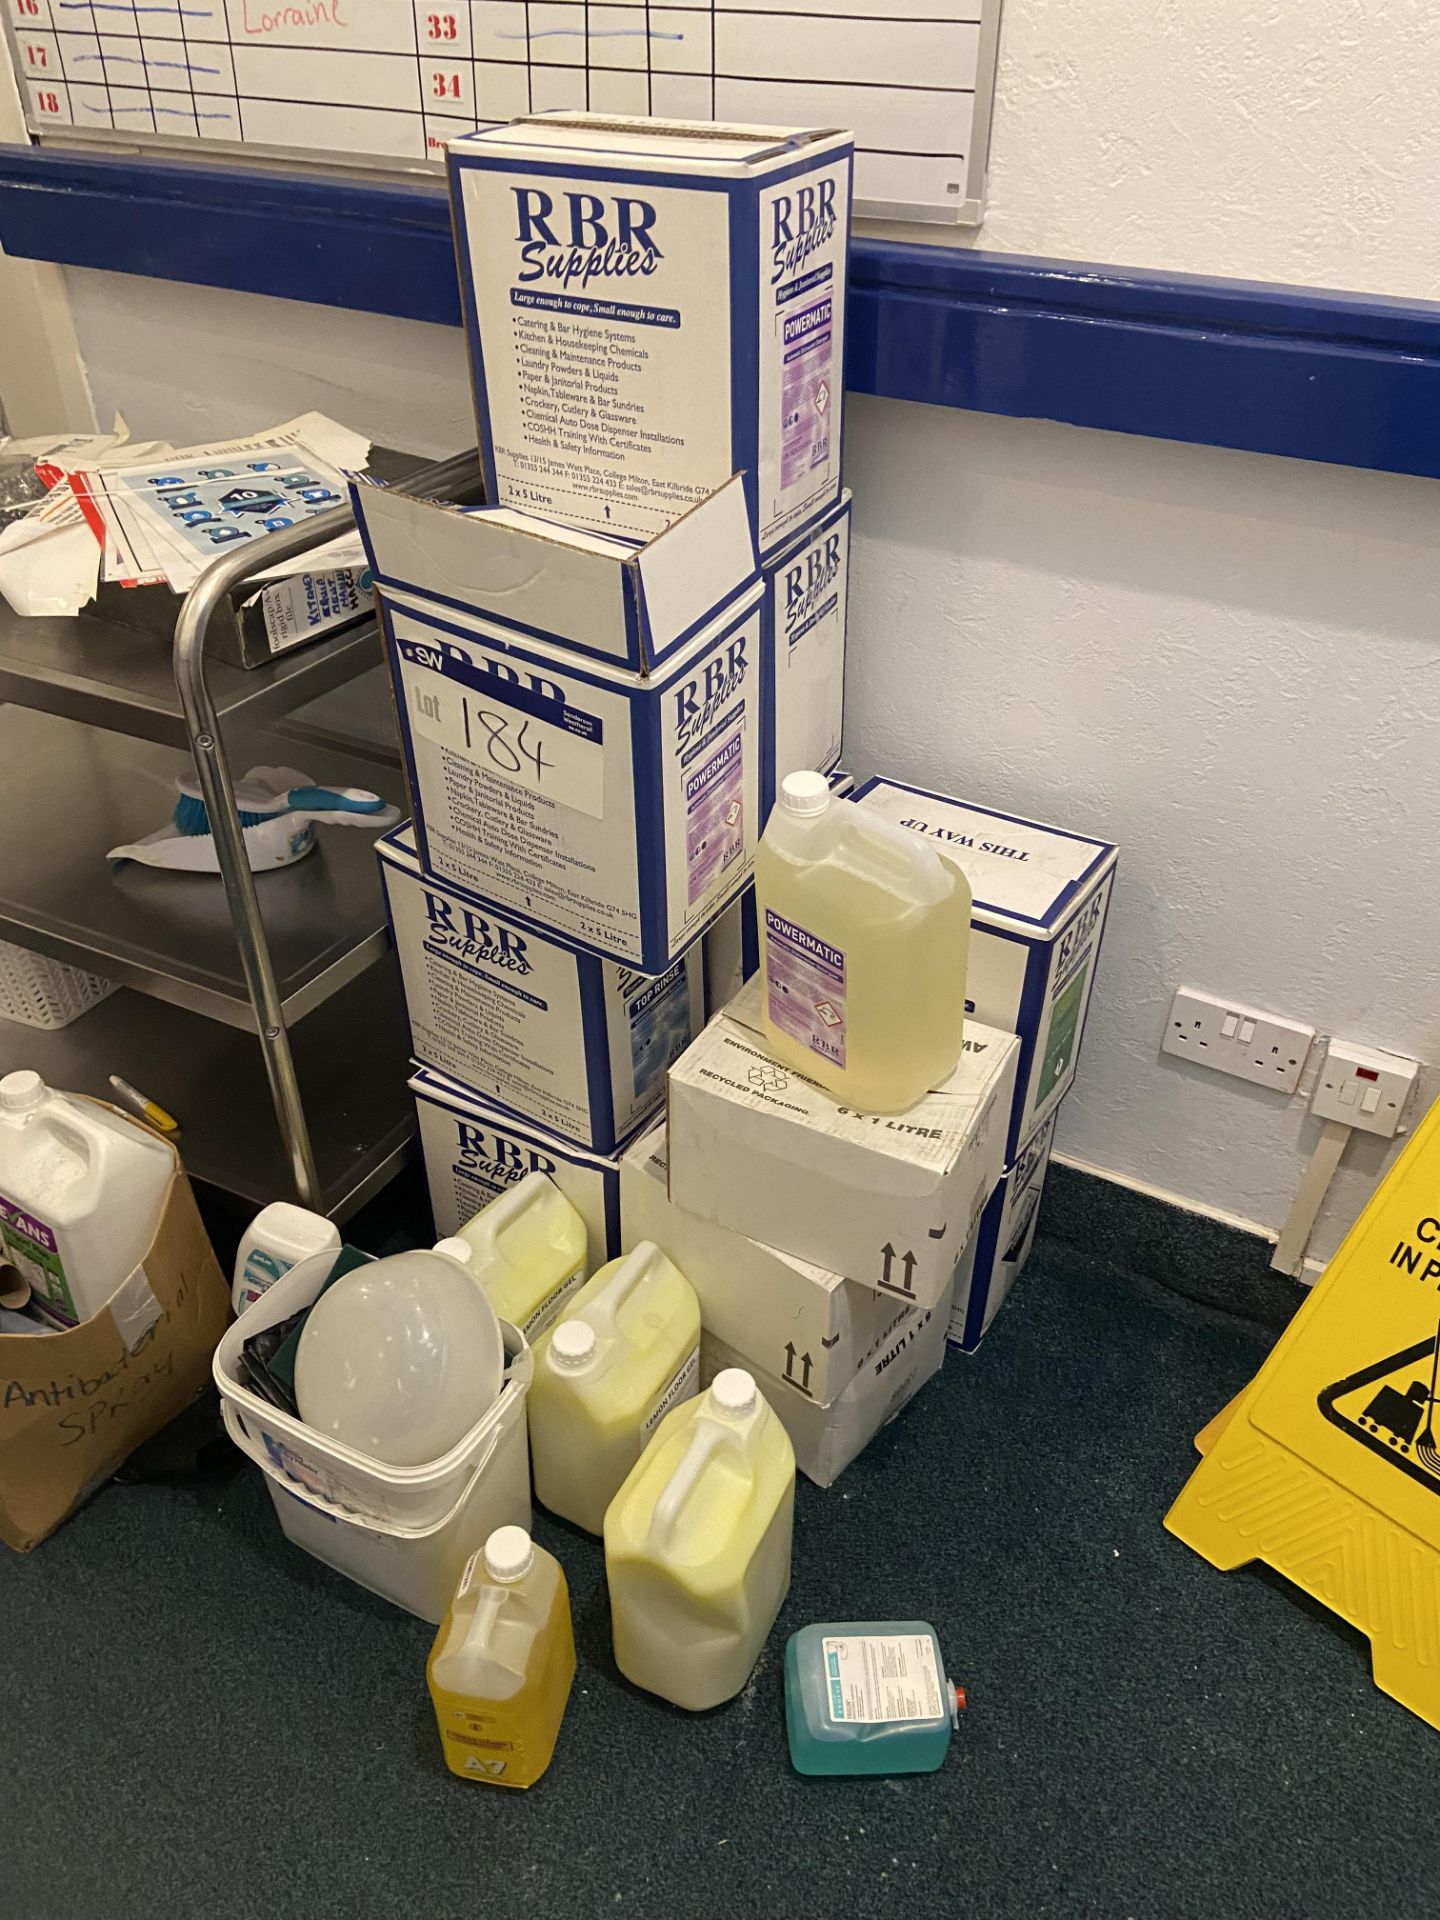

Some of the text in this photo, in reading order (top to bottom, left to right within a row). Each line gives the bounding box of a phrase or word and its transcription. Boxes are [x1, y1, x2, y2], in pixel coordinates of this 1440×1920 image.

[428, 14, 457, 40] 33
[27, 46, 47, 68] 17
[433, 73, 462, 98] 34
[37, 92, 59, 114] 18
[510, 187, 664, 259] RBR
[771, 179, 837, 249] RBR
[518, 235, 658, 289] Supplies
[771, 217, 834, 285] Supplies
[513, 290, 535, 307] Large
[535, 293, 563, 311] enough
[563, 297, 572, 309] to
[616, 304, 645, 323] enough
[646, 309, 655, 321] to
[656, 310, 676, 324] care.
[785, 303, 832, 341] POWERMATIC
[517, 315, 635, 346] Catering & Bar Hygiene Systems
[518, 329, 648, 360] Kitchen & Housekeeping Chemicals
[519, 343, 641, 372] Cleaning & Maintenance Products
[520, 356, 618, 385] Laundry Powders & Liquids
[522, 370, 617, 395] Paper & Janitorial Products
[524, 395, 636, 425] Crockery, Cutlery & Glassware
[589, 394, 595, 405] &
[597, 395, 609, 407] Bar
[611, 398, 644, 413] Sundries
[525, 408, 684, 446] Chemical Auto Dose Dispenser Installations
[526, 420, 651, 454] COSHH Training With Certificates
[528, 433, 625, 462] Health & Safety Information
[230, 491, 258, 501] 10
[508, 484, 552, 505] 2 x 5 Litre
[694, 485, 709, 496] G74
[784, 533, 841, 609] RBR
[274, 592, 289, 640] rigid box
[416, 647, 443, 672] SW
[674, 636, 749, 730] RBR
[414, 686, 441, 722] Lot
[675, 664, 746, 757] Supplies
[462, 697, 556, 783] 184
[687, 737, 741, 796] POWERMATIC
[523, 788, 555, 809] Products
[900, 818, 1030, 862] THIS WAY UP
[438, 855, 444, 866] 2
[451, 863, 456, 872] 5
[458, 866, 479, 882] Litre
[420, 888, 534, 972] RBR
[579, 920, 586, 930] 2
[596, 927, 601, 936] 5
[604, 930, 627, 948] Litre
[767, 913, 842, 966] POWERMATIC
[428, 922, 532, 976] Supplies
[635, 990, 653, 1011] TOP
[654, 964, 680, 995] RINSE
[723, 1037, 791, 1072] ENVIRONMENT
[812, 1034, 840, 1057] RBR
[699, 1068, 810, 1115] RECYCLED PACKAGING
[837, 1107, 943, 1140] 6 x 1 LITRE
[459, 1150, 528, 1182] Suppl
[1389, 1241, 1423, 1274] IN
[523, 1275, 576, 1334] EMON FLOOR GEL
[875, 1340, 907, 1376] LITRE
[646, 1358, 697, 1429] LEMON FLOOR GEL
